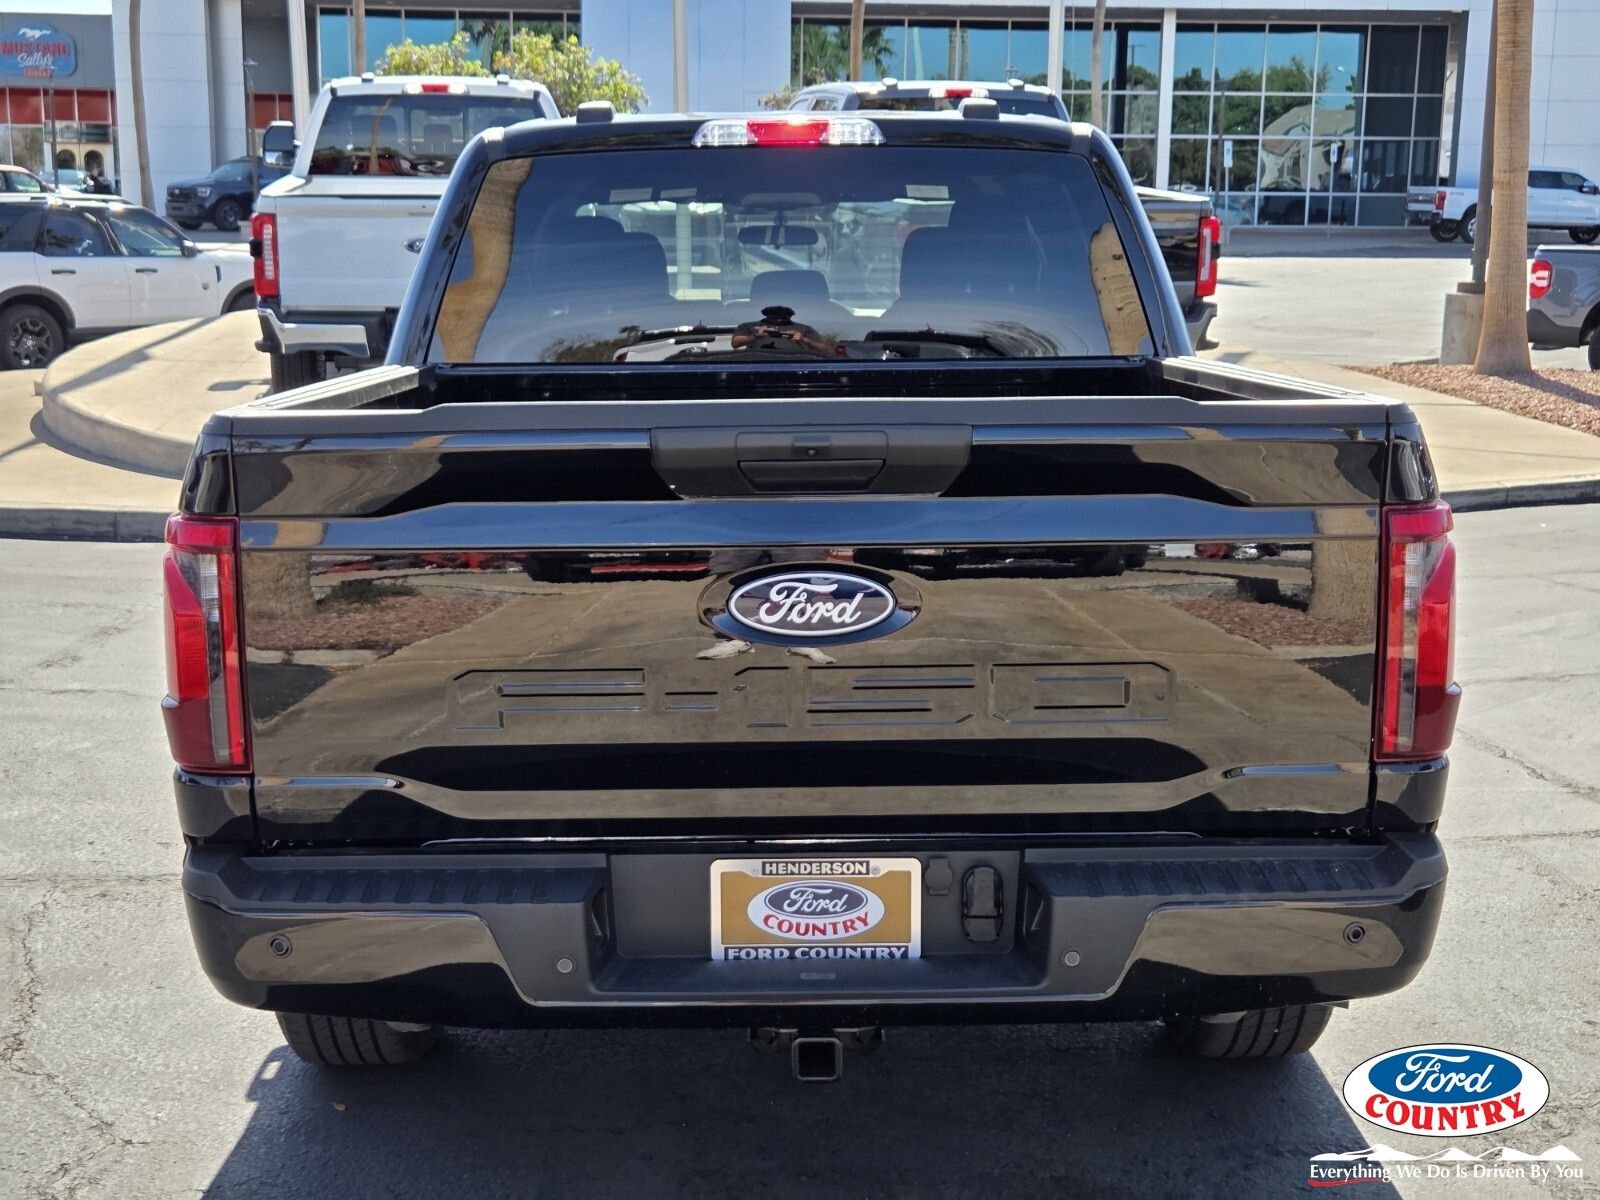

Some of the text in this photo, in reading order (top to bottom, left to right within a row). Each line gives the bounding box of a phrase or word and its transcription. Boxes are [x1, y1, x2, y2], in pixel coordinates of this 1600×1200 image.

[759, 581, 864, 624] Ford
[445, 663, 1175, 729] F-150
[764, 861, 867, 875] HENDERSON
[783, 886, 850, 913] Ford
[762, 911, 870, 937] COUNTRY
[727, 947, 906, 960] FORD COUNTRY
